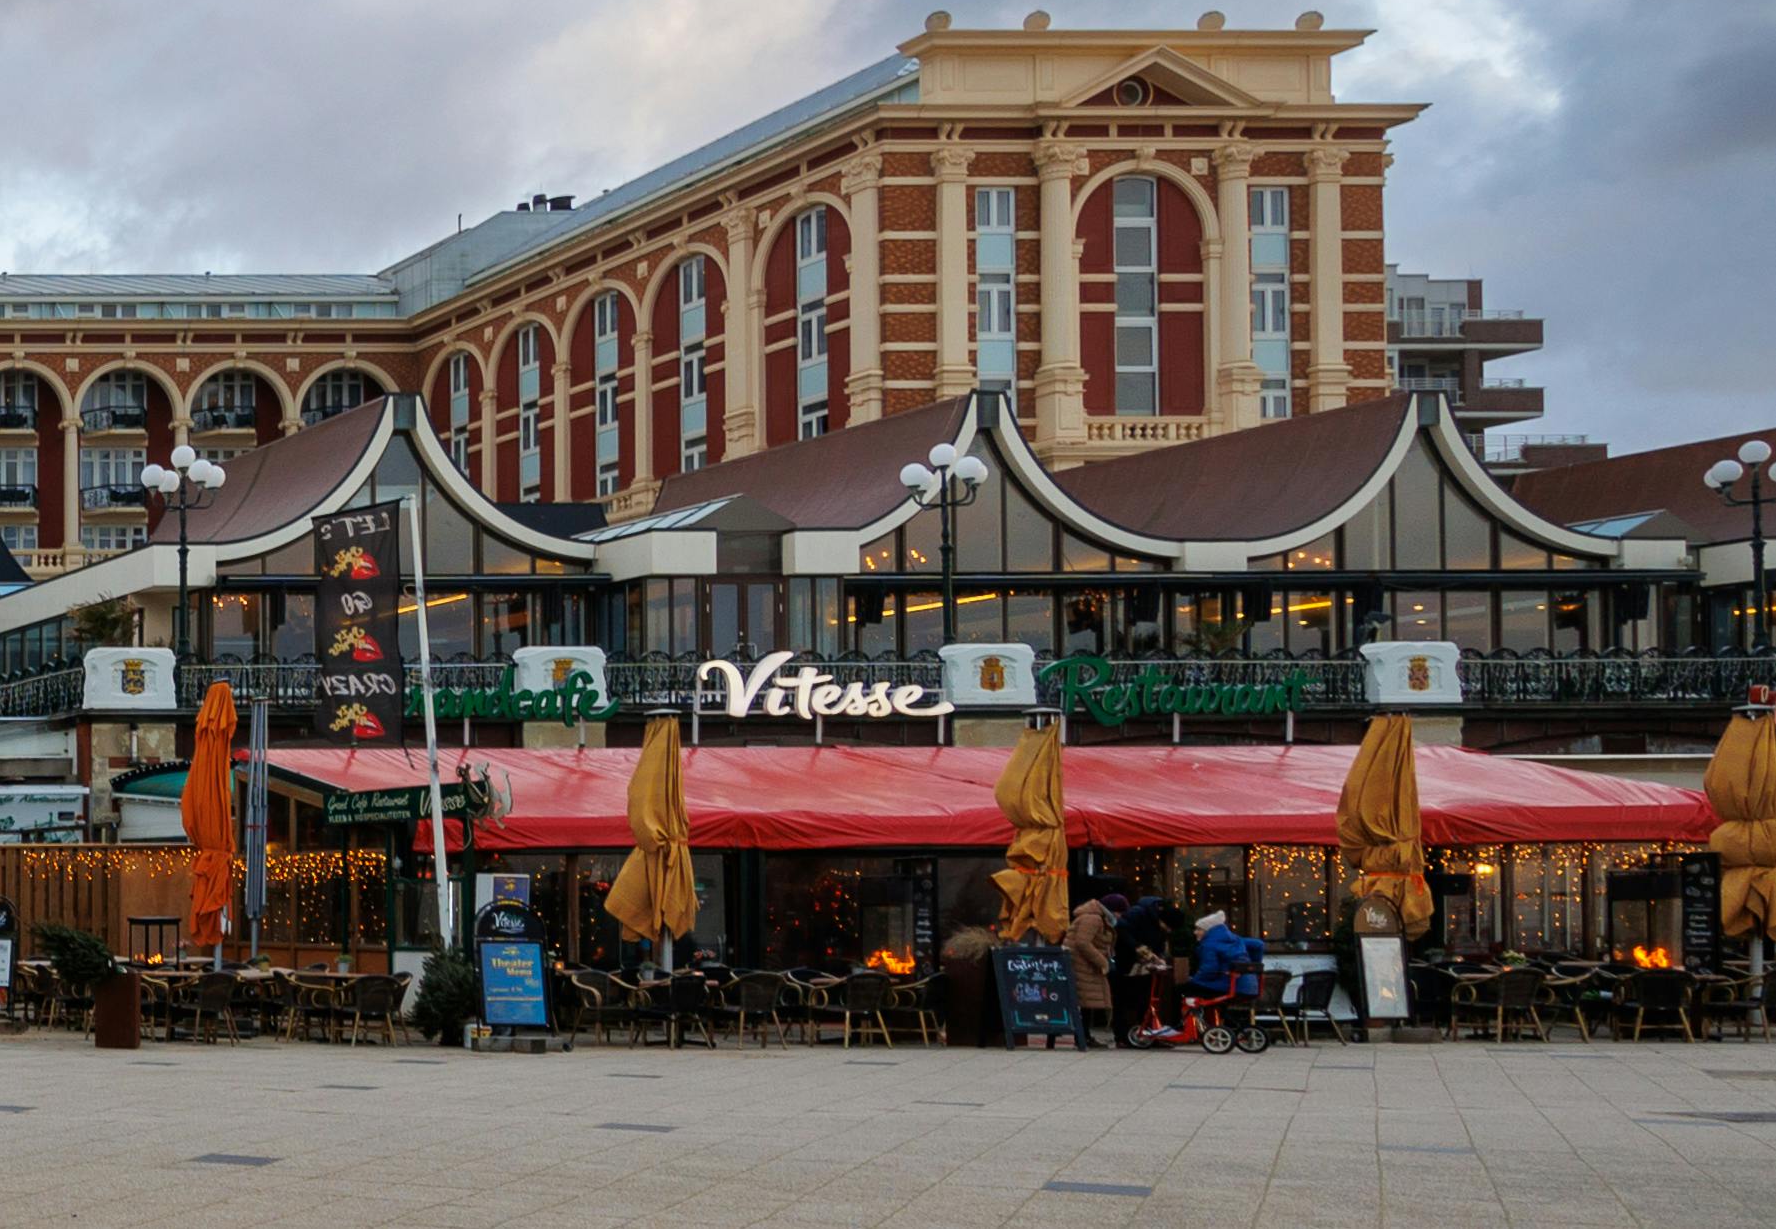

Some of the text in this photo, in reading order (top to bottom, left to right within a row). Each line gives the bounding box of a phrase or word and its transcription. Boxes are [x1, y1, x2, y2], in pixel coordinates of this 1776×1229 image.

[403, 664, 620, 728] randcafe
[699, 651, 955, 720] Vitesse
[1038, 657, 1322, 726] Restaurant
[492, 911, 525, 931] Vitesse
